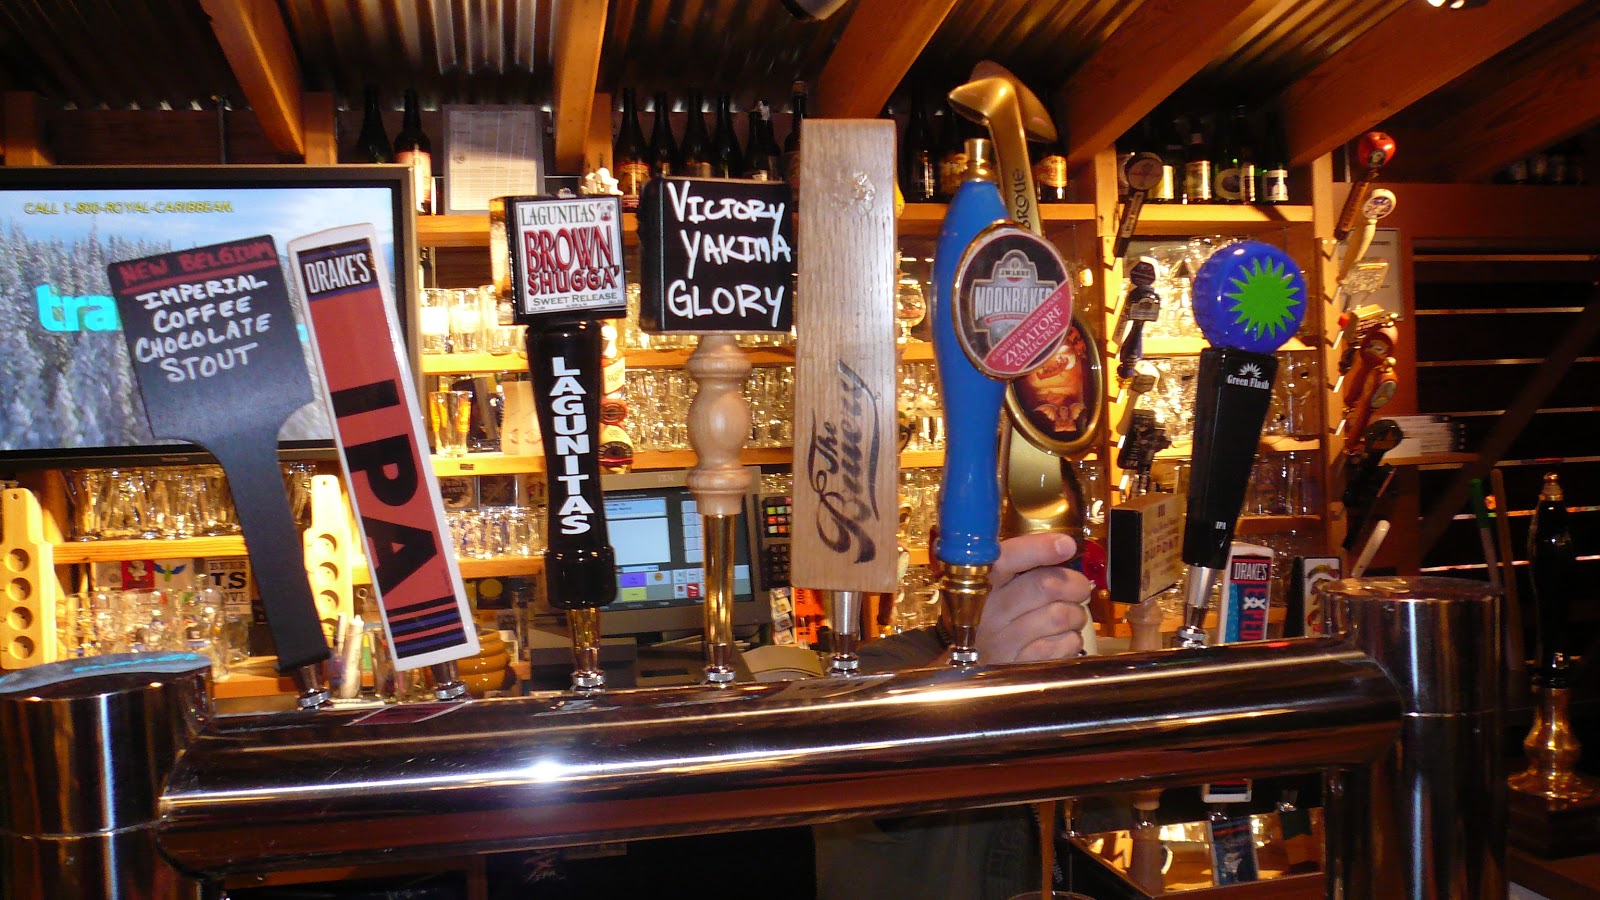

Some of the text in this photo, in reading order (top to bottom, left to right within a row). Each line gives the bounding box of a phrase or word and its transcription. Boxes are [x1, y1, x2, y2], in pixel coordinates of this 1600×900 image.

[24, 202, 59, 214] CALL
[521, 203, 596, 226] LAGUNITAS
[667, 181, 786, 243] VICTORY
[119, 241, 274, 284] NEW BELGIUM
[524, 225, 615, 275] BROWN
[680, 229, 792, 280] YAKIMA
[136, 275, 269, 311] IMPERIAL
[303, 252, 372, 294] DRAKE'S
[153, 296, 253, 334] COFFEE
[533, 296, 570, 306] SWEET
[571, 292, 618, 303] RELEASE
[668, 279, 786, 328] GLORY
[135, 313, 272, 363] CHOCOLATE
[1002, 306, 1063, 366] ZYMATORE
[1014, 321, 1063, 367] COLLECTION
[160, 342, 259, 384] STOUT
[1227, 374, 1270, 390] Green Flash
[550, 357, 595, 535] LAGUNITAS
[329, 379, 438, 598] IPA
